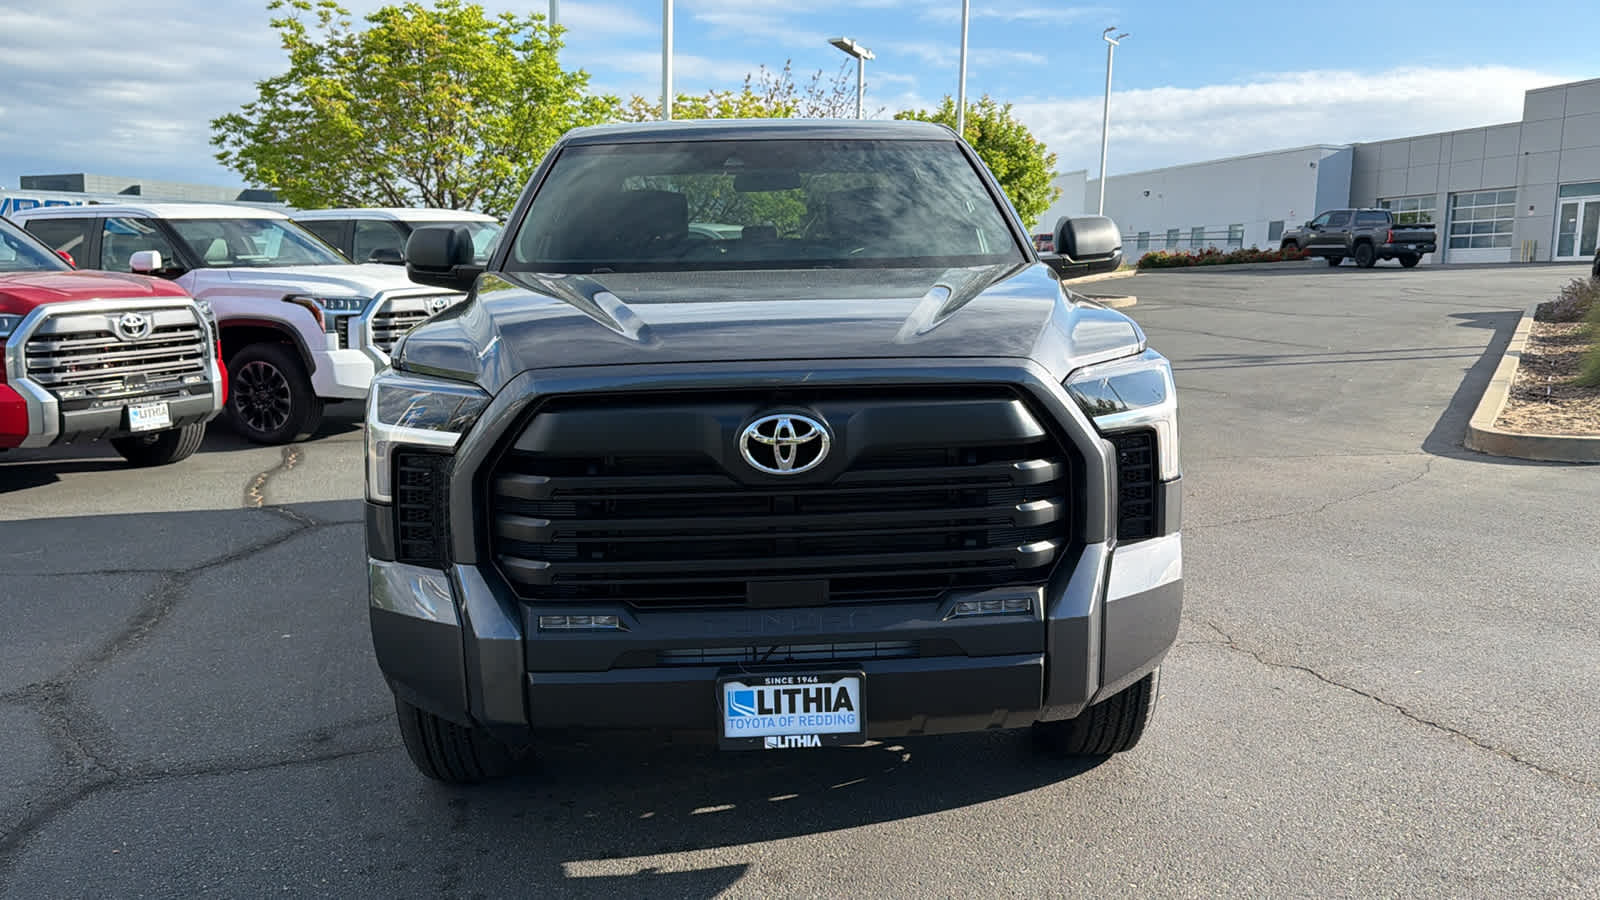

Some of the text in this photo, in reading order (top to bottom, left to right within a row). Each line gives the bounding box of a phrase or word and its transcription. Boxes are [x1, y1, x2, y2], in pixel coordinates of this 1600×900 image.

[765, 676, 818, 685] SINCE 1946
[757, 686, 854, 715] LITHIA
[728, 714, 856, 729] TOYOTA OF REDDING
[777, 735, 822, 748] LITHIA
